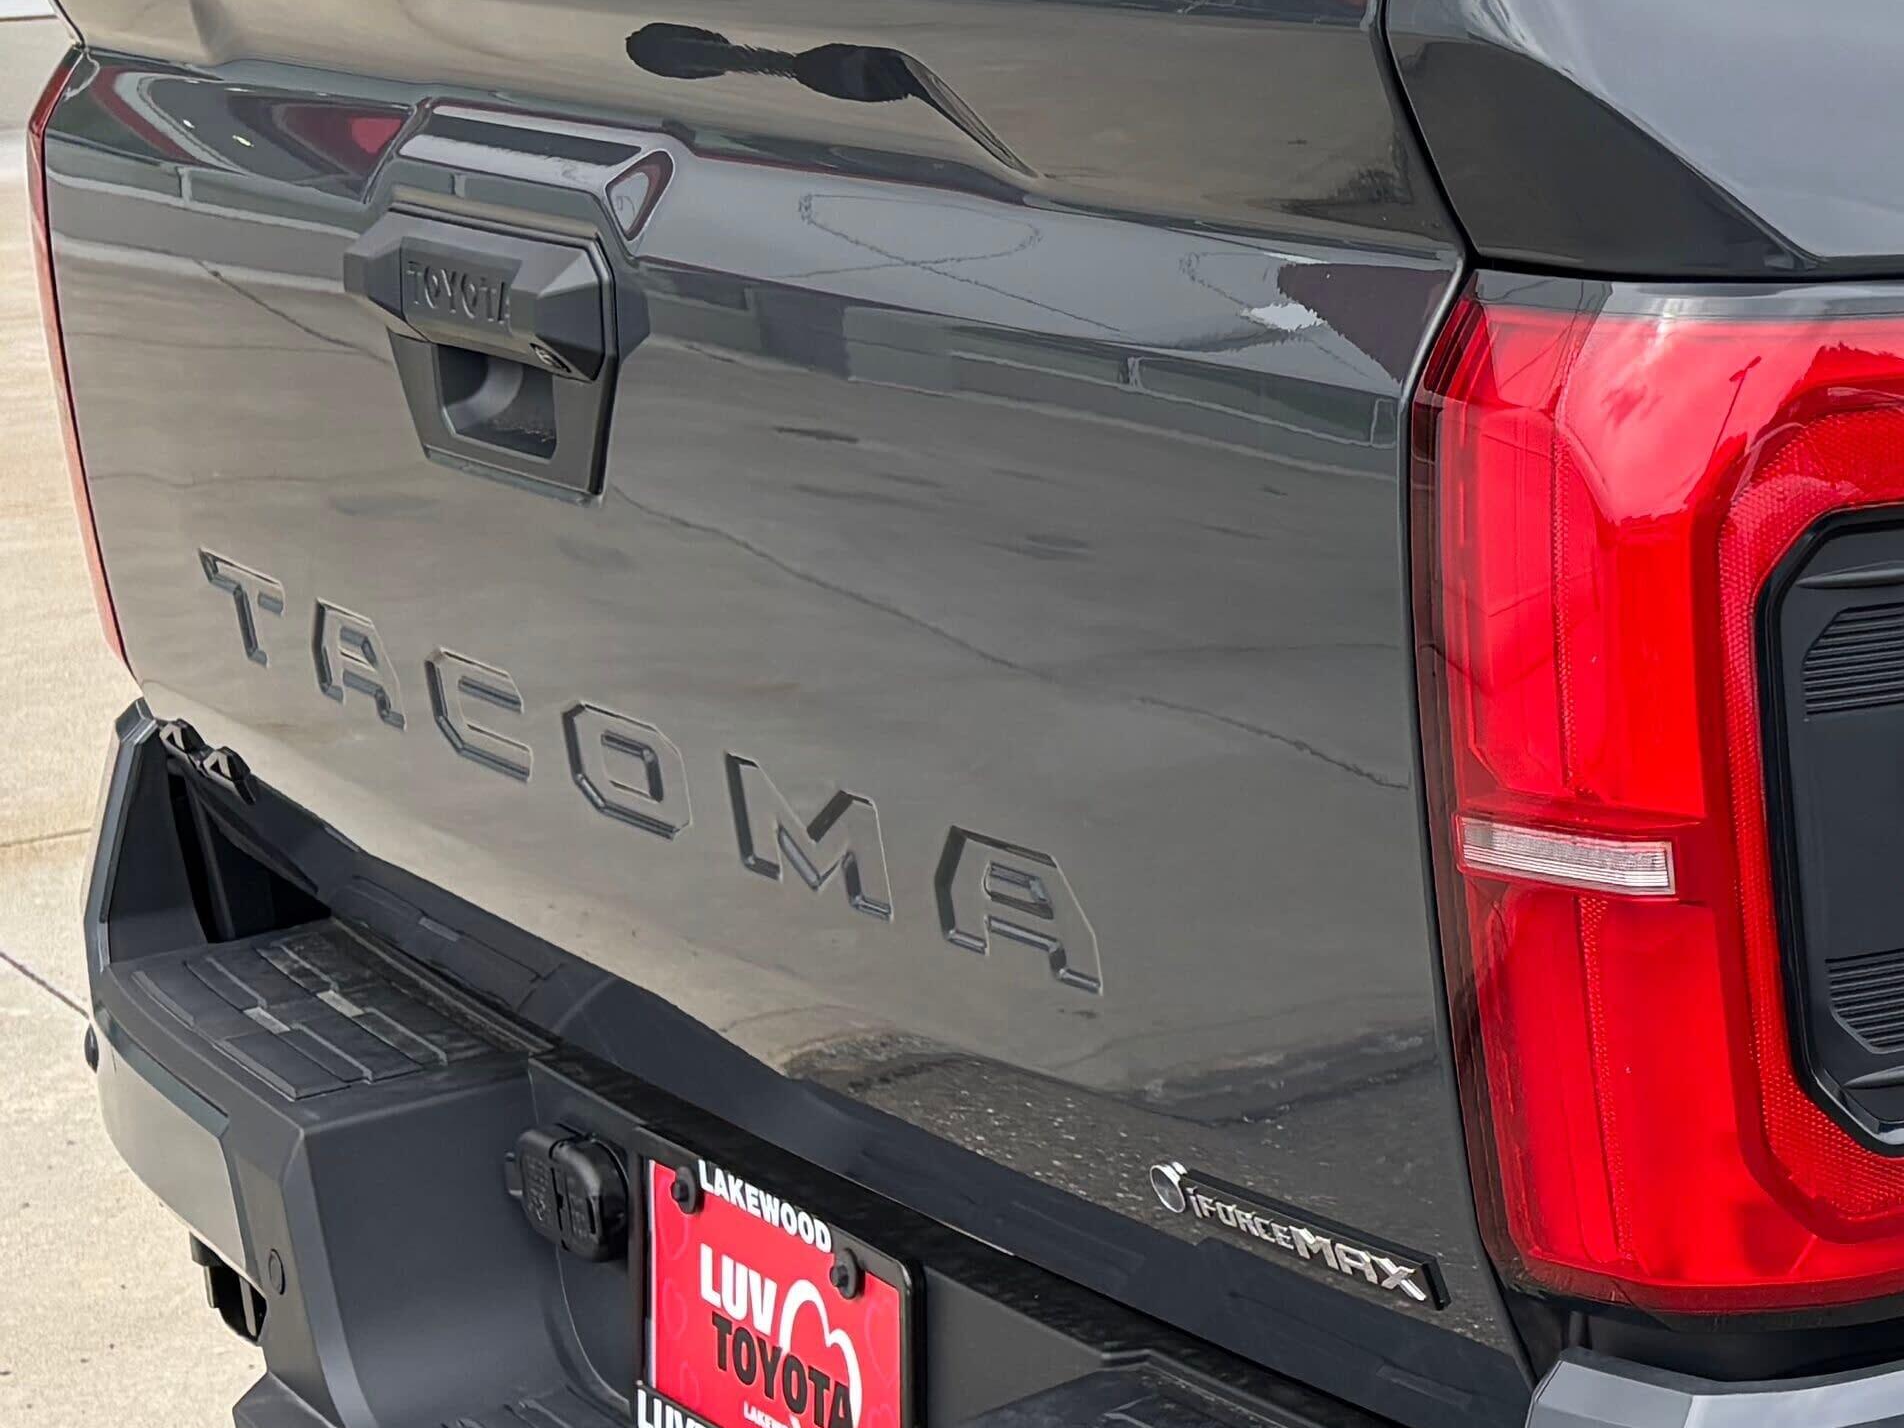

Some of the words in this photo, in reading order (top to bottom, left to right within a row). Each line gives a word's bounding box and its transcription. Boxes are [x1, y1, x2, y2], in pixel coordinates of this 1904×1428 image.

[406, 260, 512, 325] TOYOTA
[200, 548, 1104, 995] TACOMA
[698, 1158, 832, 1254] LAKEWOOD
[700, 1243, 777, 1337] LUV
